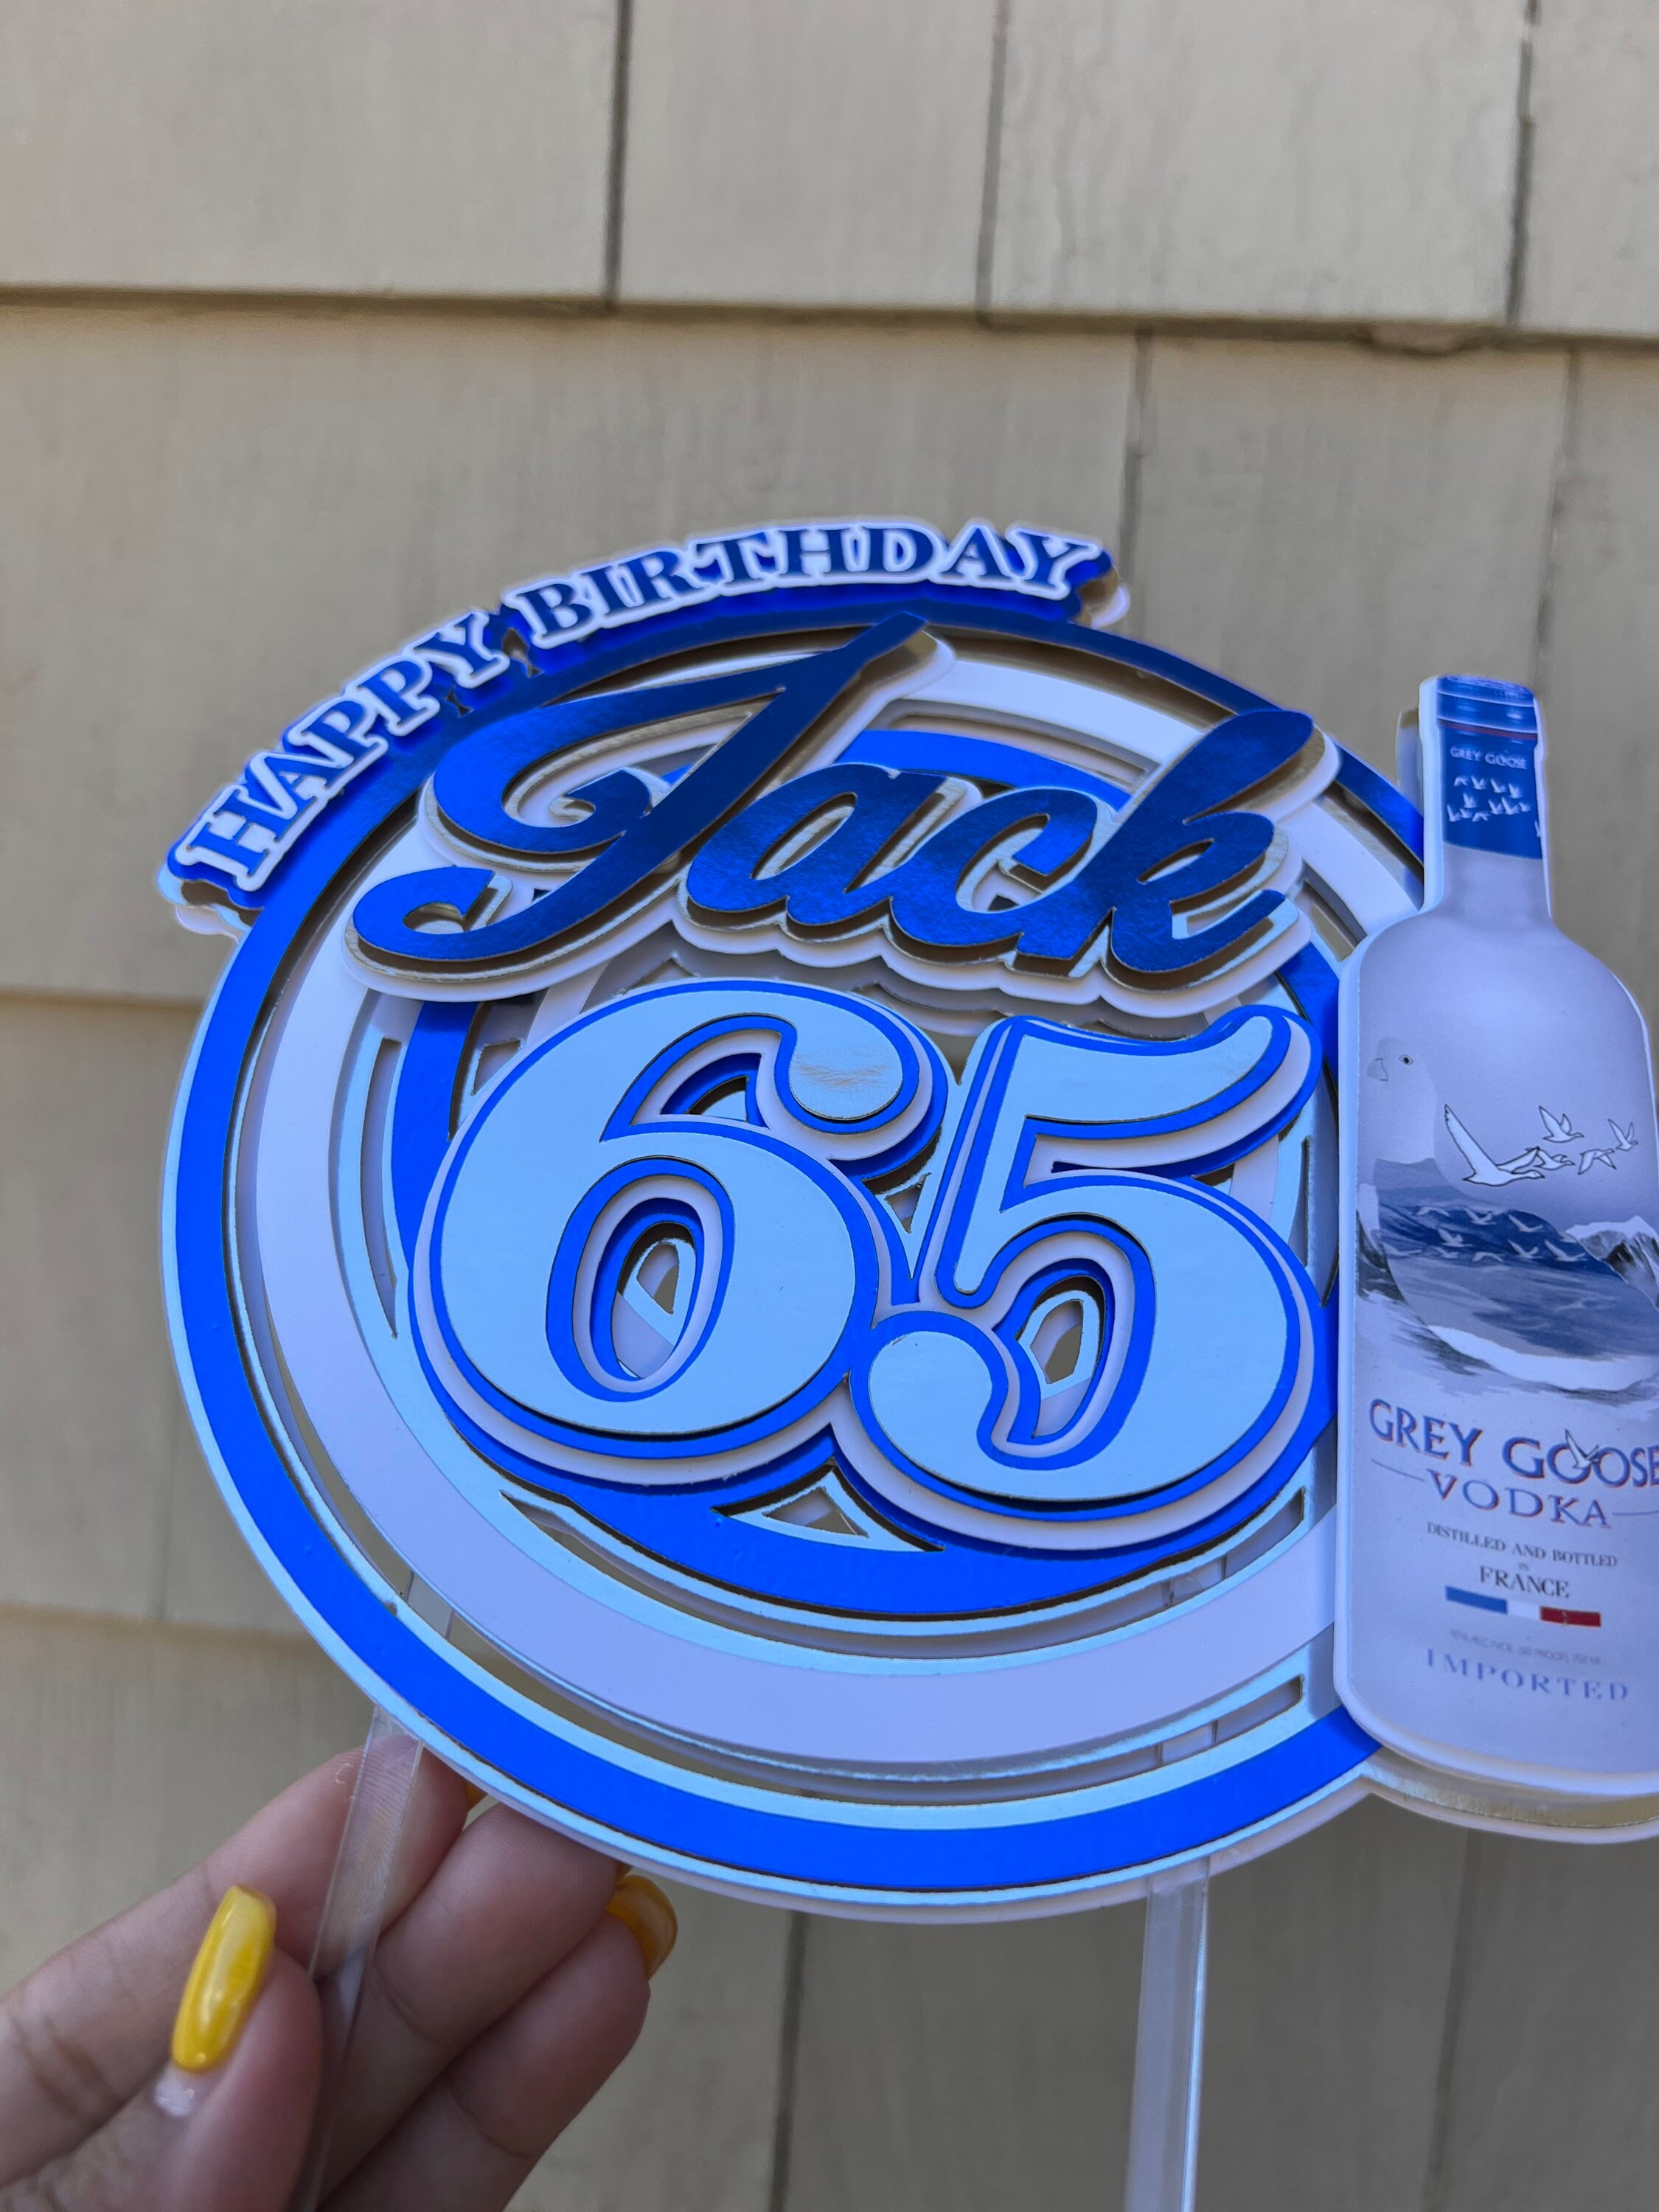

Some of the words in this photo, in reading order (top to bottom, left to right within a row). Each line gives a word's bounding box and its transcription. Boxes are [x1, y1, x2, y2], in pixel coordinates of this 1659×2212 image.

[181, 612, 506, 879] HAPPY
[518, 526, 1097, 638] BIRTHDAY
[1450, 745, 1483, 762] GREY
[1485, 750, 1528, 770] GOOSE
[352, 613, 1314, 975] Jack
[424, 979, 1321, 1516] 65
[1369, 1398, 1483, 1467] GREY
[1426, 1468, 1612, 1529] VODKA
[1427, 1521, 1506, 1552] DISTILLED
[1512, 1543, 1546, 1560] AND
[1552, 1548, 1618, 1568] BOTTLED
[1479, 1565, 1570, 1599] FRANCE
[1426, 1648, 1629, 1701] IMPORTED
